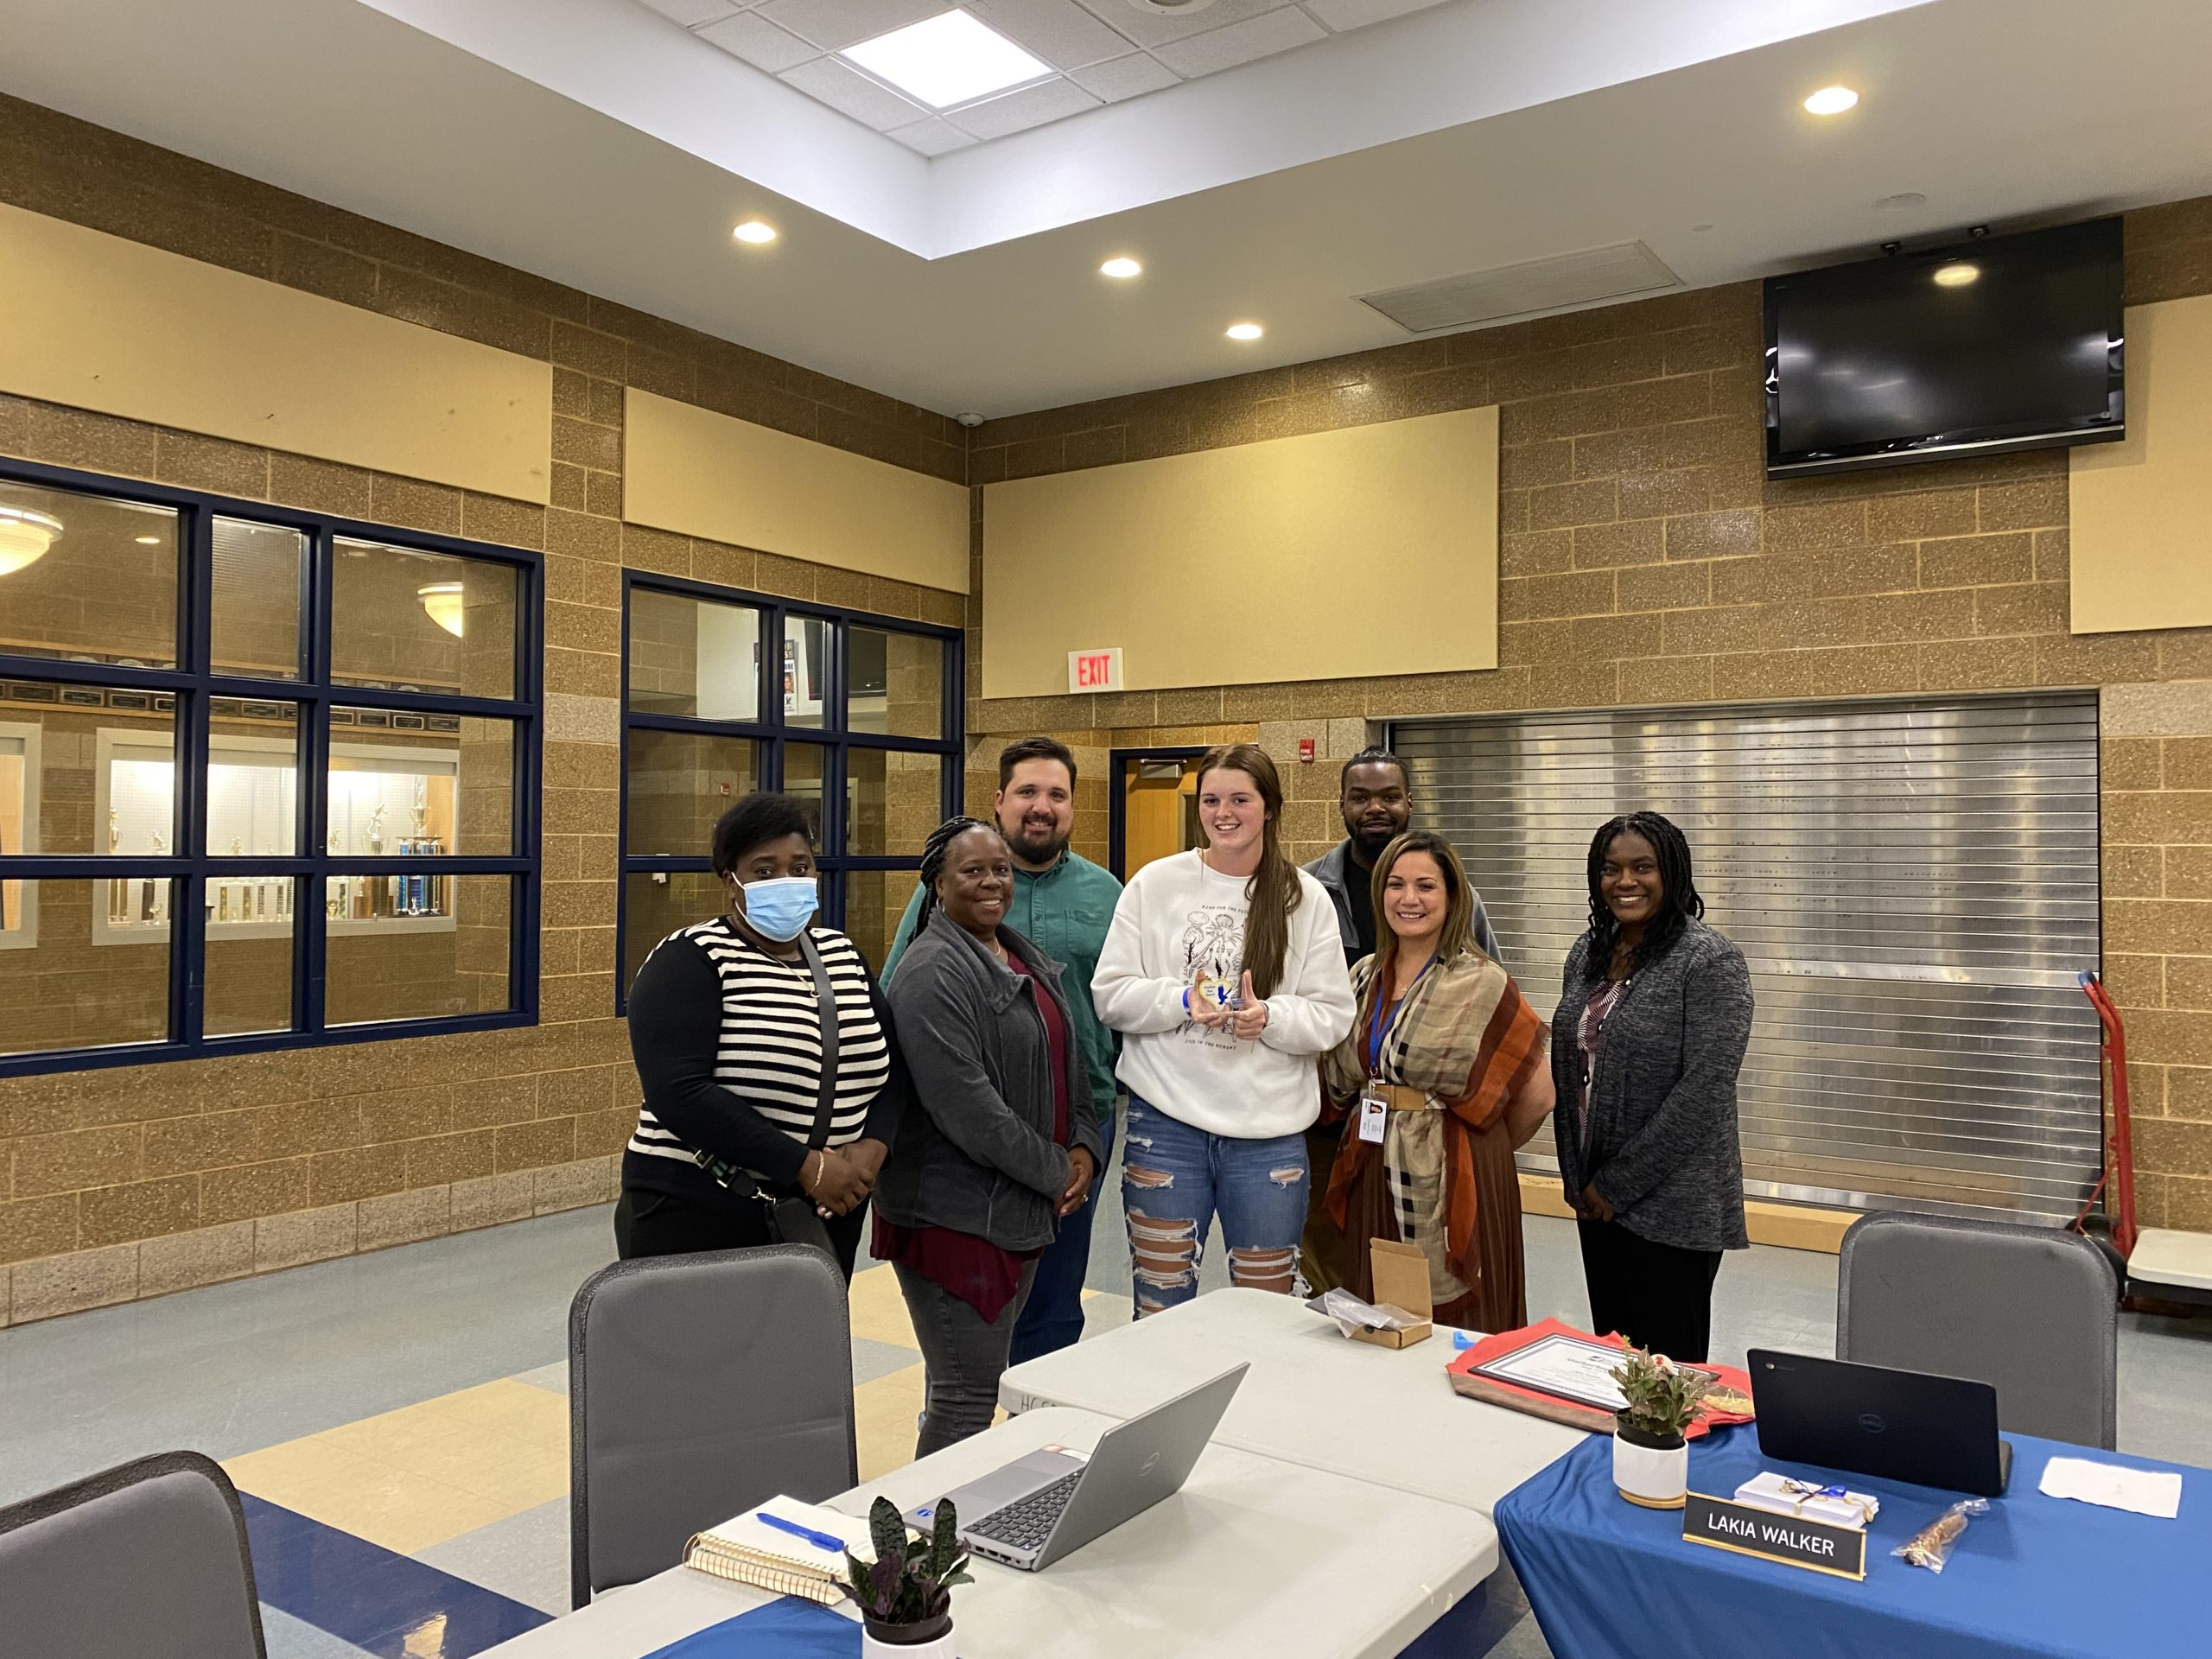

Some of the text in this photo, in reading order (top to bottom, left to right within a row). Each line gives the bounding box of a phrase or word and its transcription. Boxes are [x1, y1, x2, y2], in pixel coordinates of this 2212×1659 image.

[1077, 655, 1110, 686] EXIT
[1708, 1512, 1834, 1557] LAKIA WALKER
